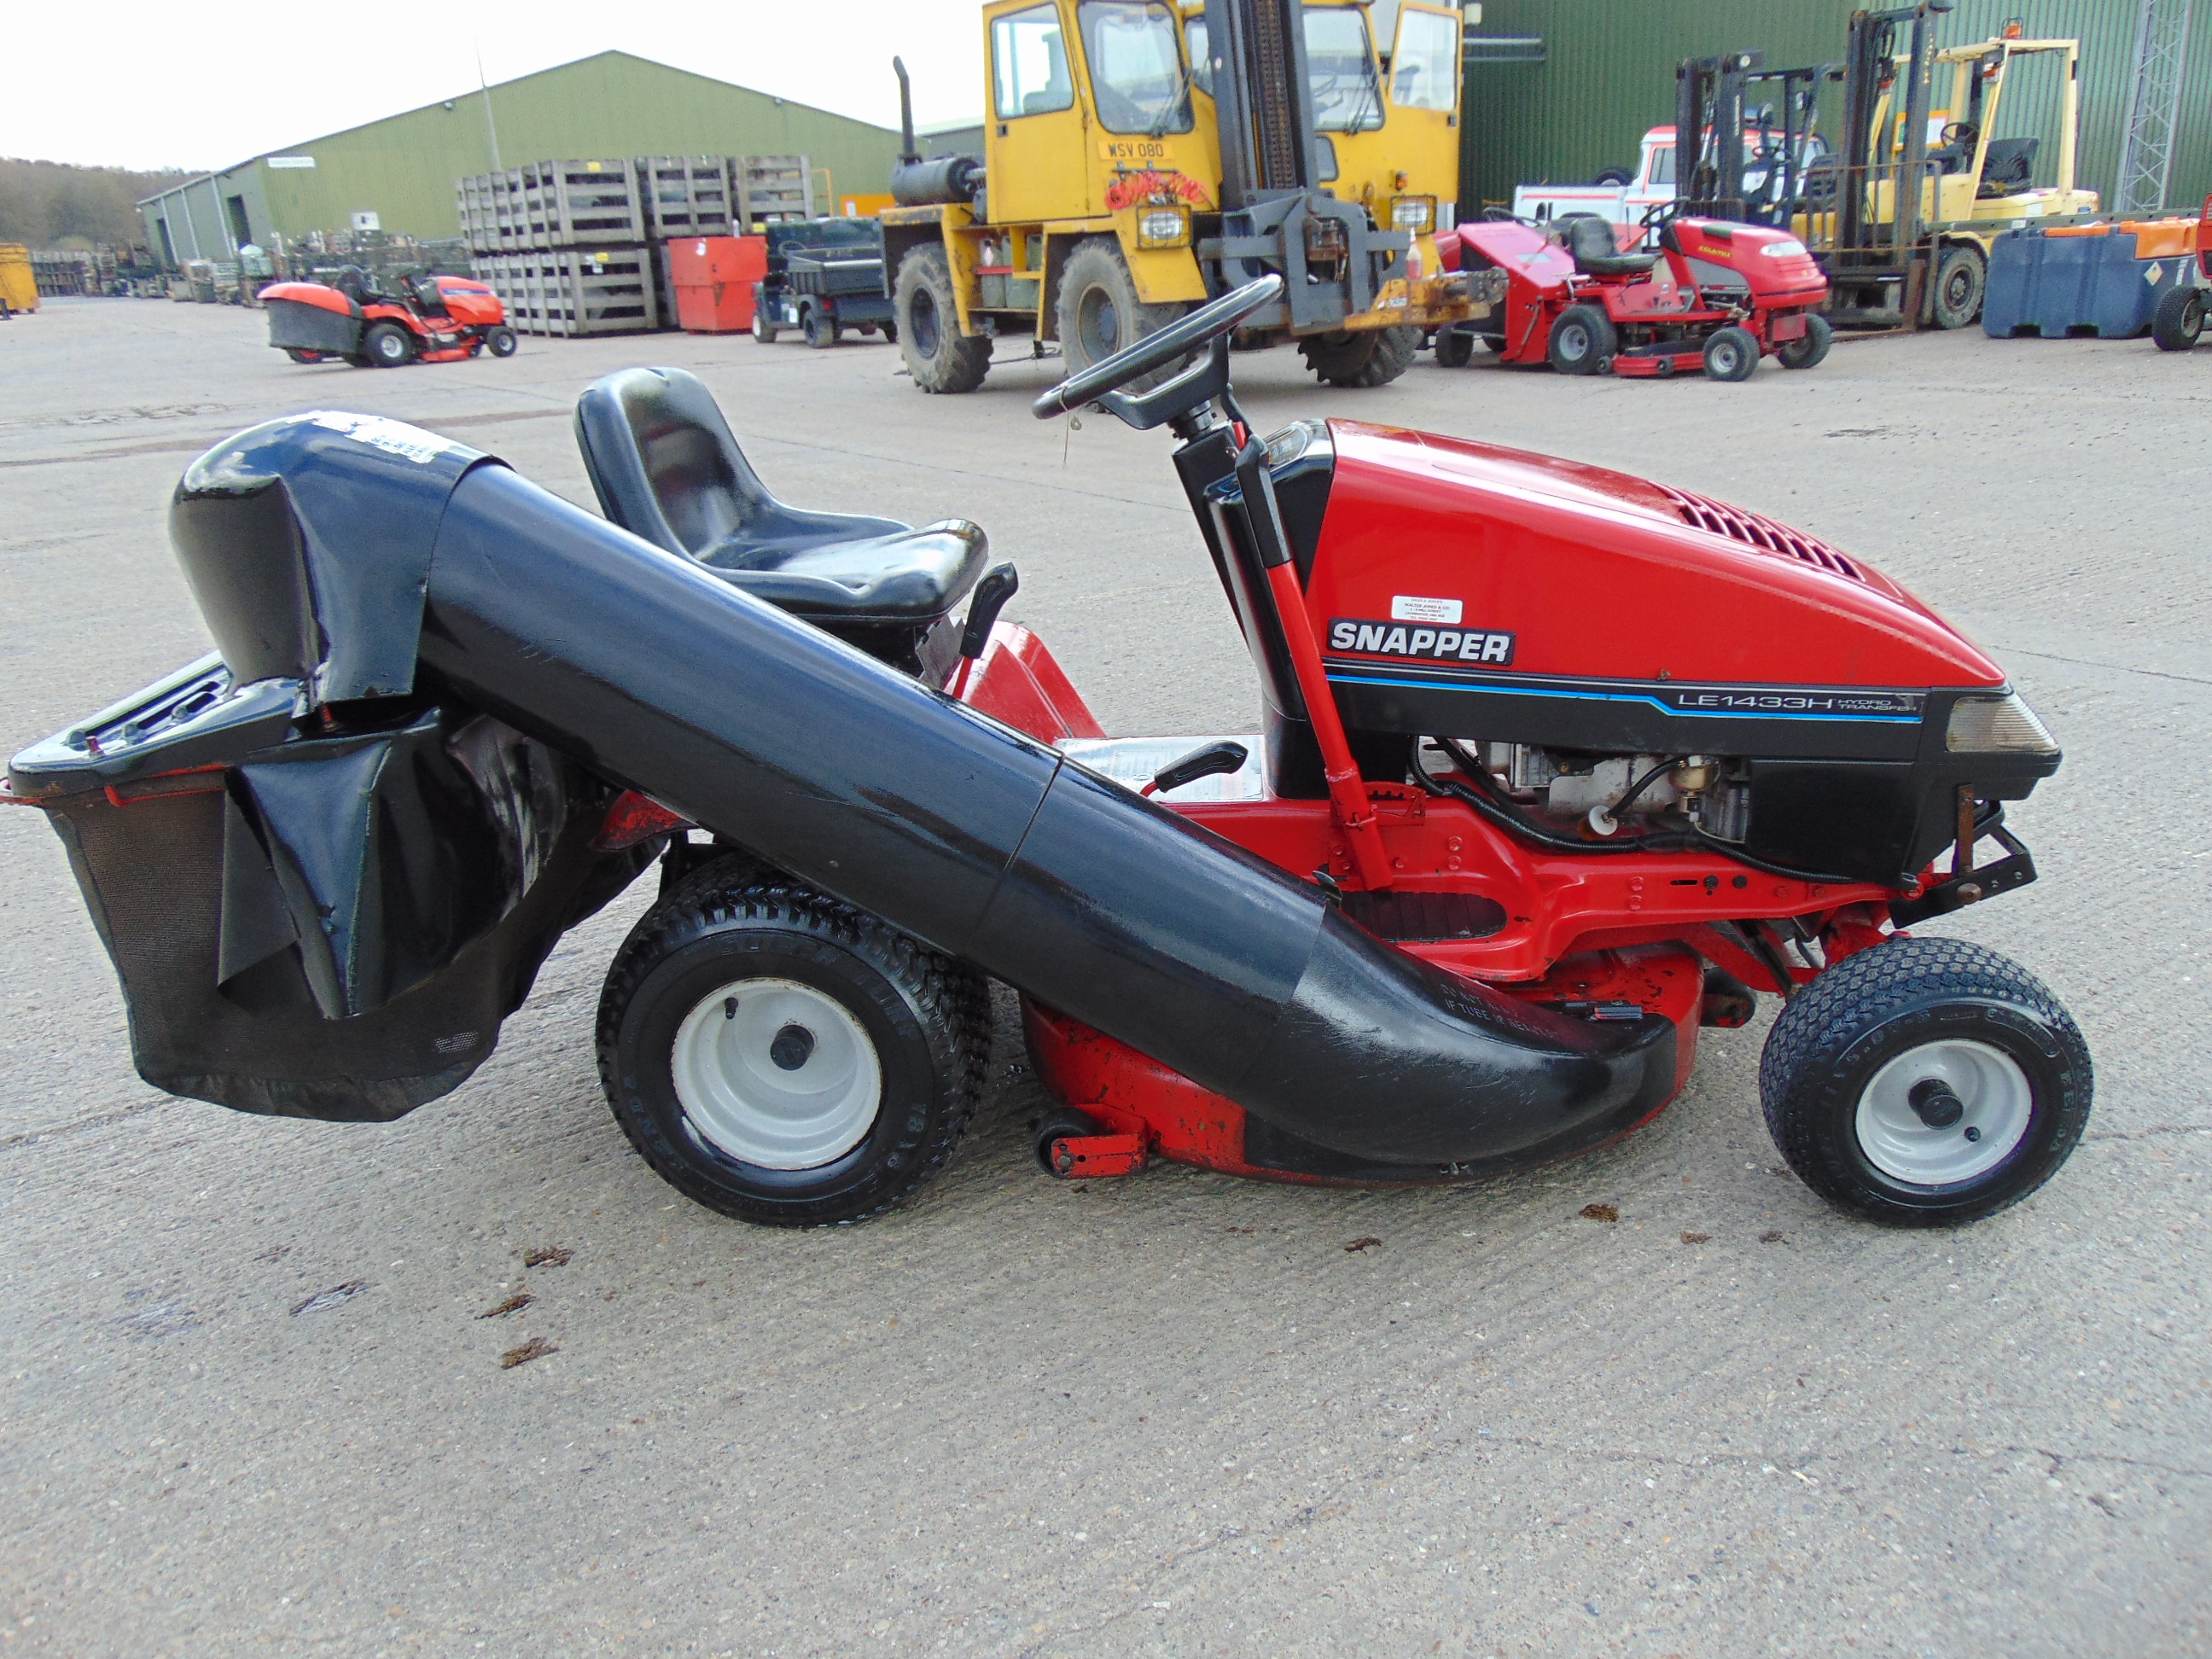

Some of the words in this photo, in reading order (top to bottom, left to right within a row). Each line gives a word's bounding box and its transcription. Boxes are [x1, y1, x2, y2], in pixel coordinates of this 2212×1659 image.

[1109, 143, 1133, 157] WSV
[1331, 622, 1510, 662] SNAPPER
[1678, 694, 1833, 709] LE1433H
